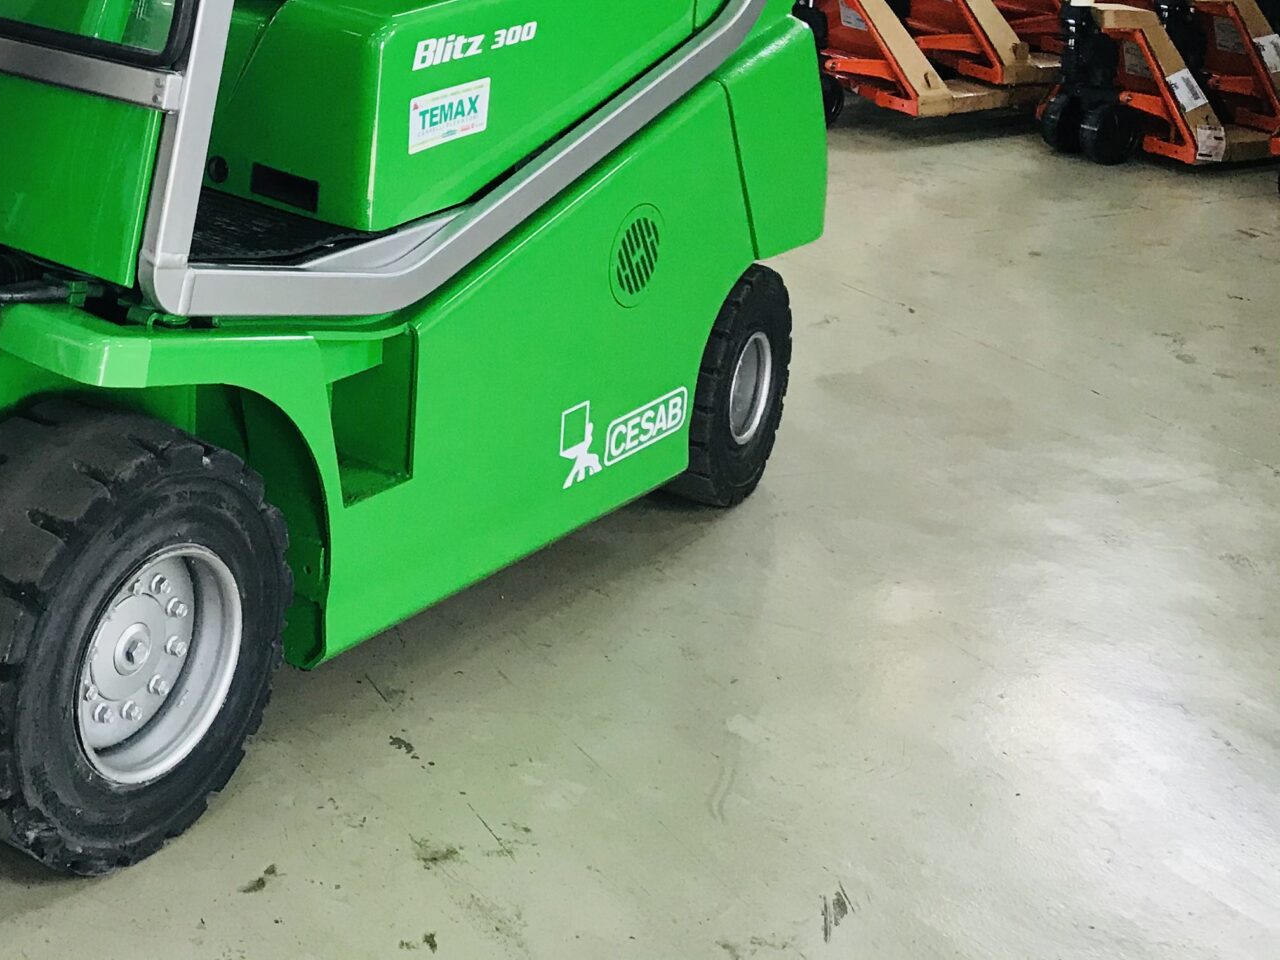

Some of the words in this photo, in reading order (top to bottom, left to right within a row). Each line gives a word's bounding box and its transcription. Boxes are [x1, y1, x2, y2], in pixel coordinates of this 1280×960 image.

[412, 33, 485, 72] Blitz
[490, 20, 538, 50] 300
[418, 94, 480, 130] TEMAX
[609, 396, 683, 457] CESAB
